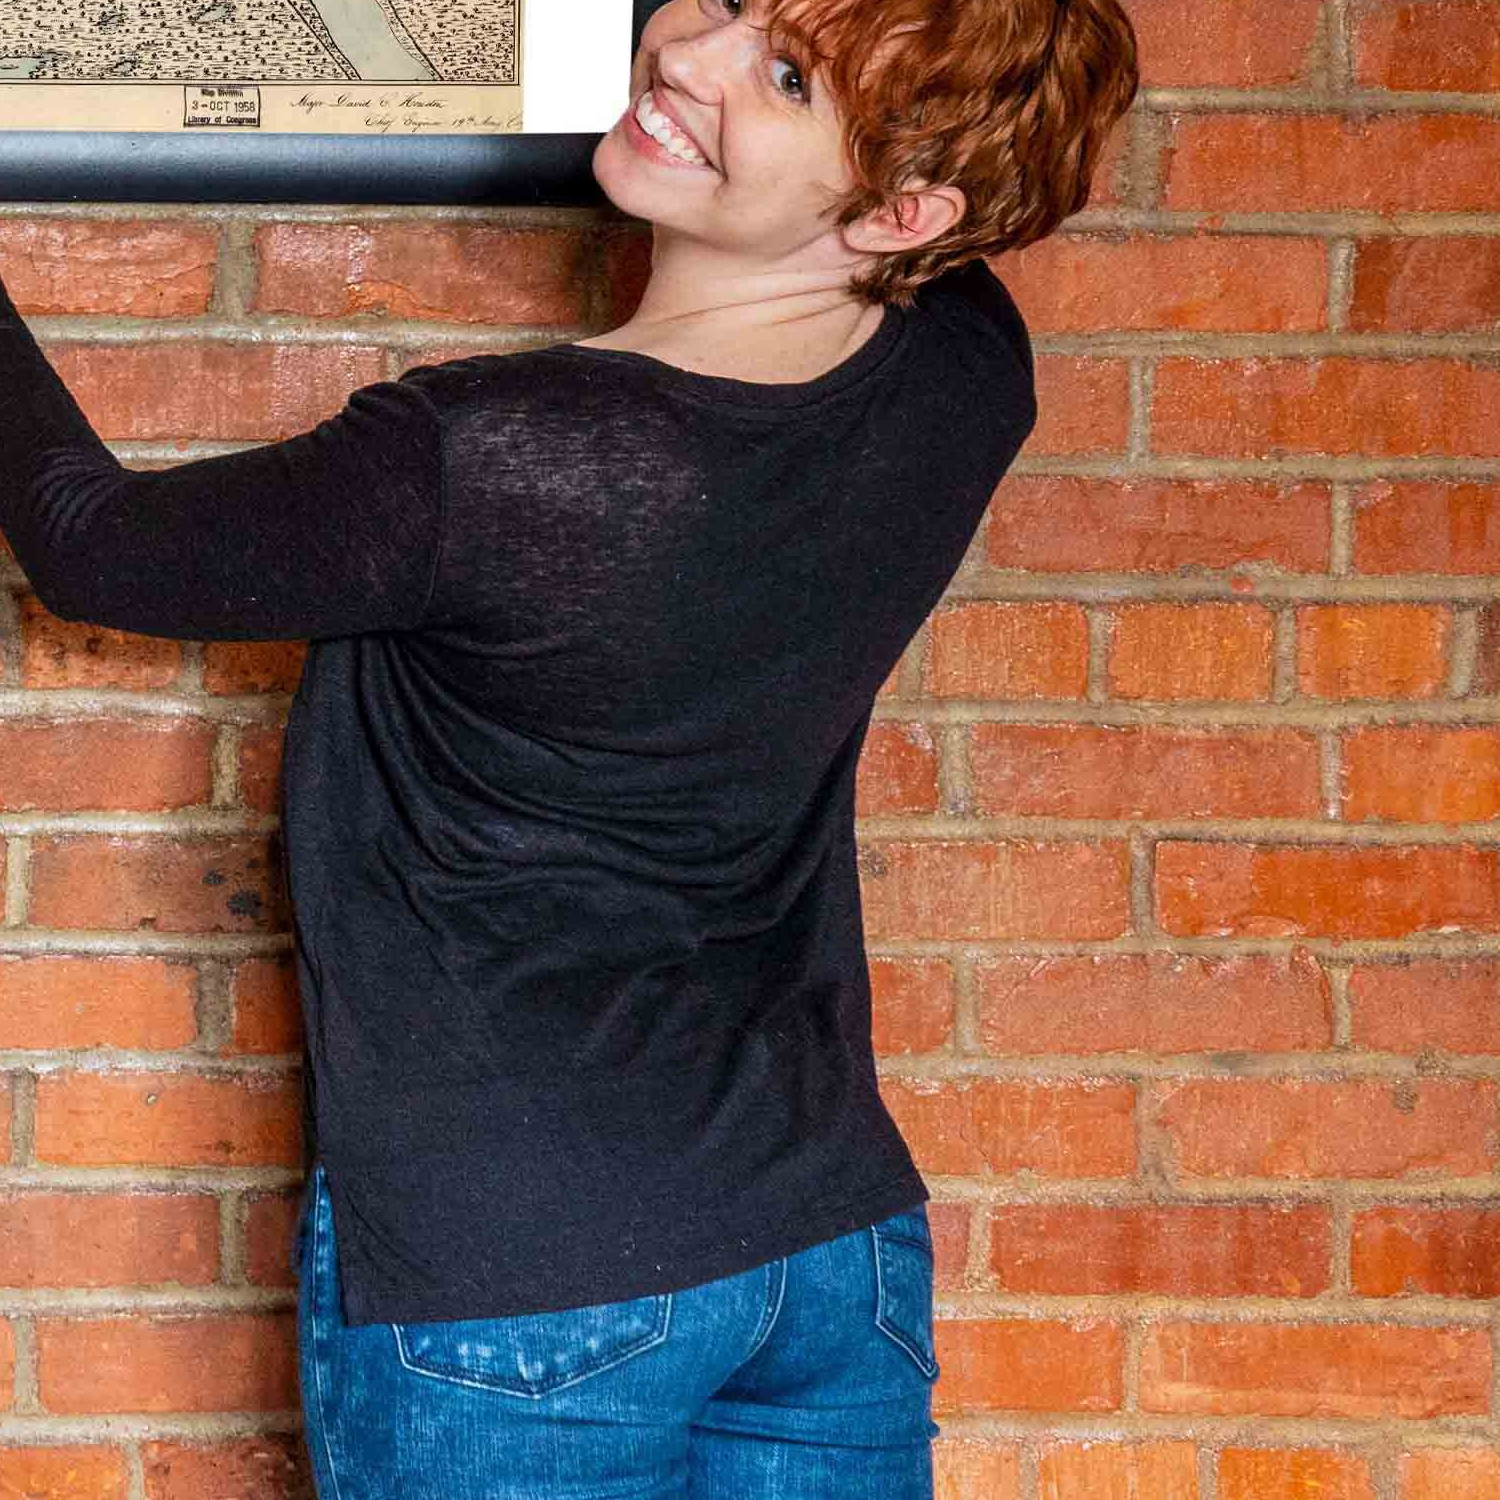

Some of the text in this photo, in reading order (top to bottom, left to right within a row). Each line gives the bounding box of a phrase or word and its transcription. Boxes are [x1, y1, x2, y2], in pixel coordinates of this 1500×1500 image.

[234, 101, 255, 112] 1958
[188, 116, 211, 124] Library
[226, 116, 257, 124] Congress
